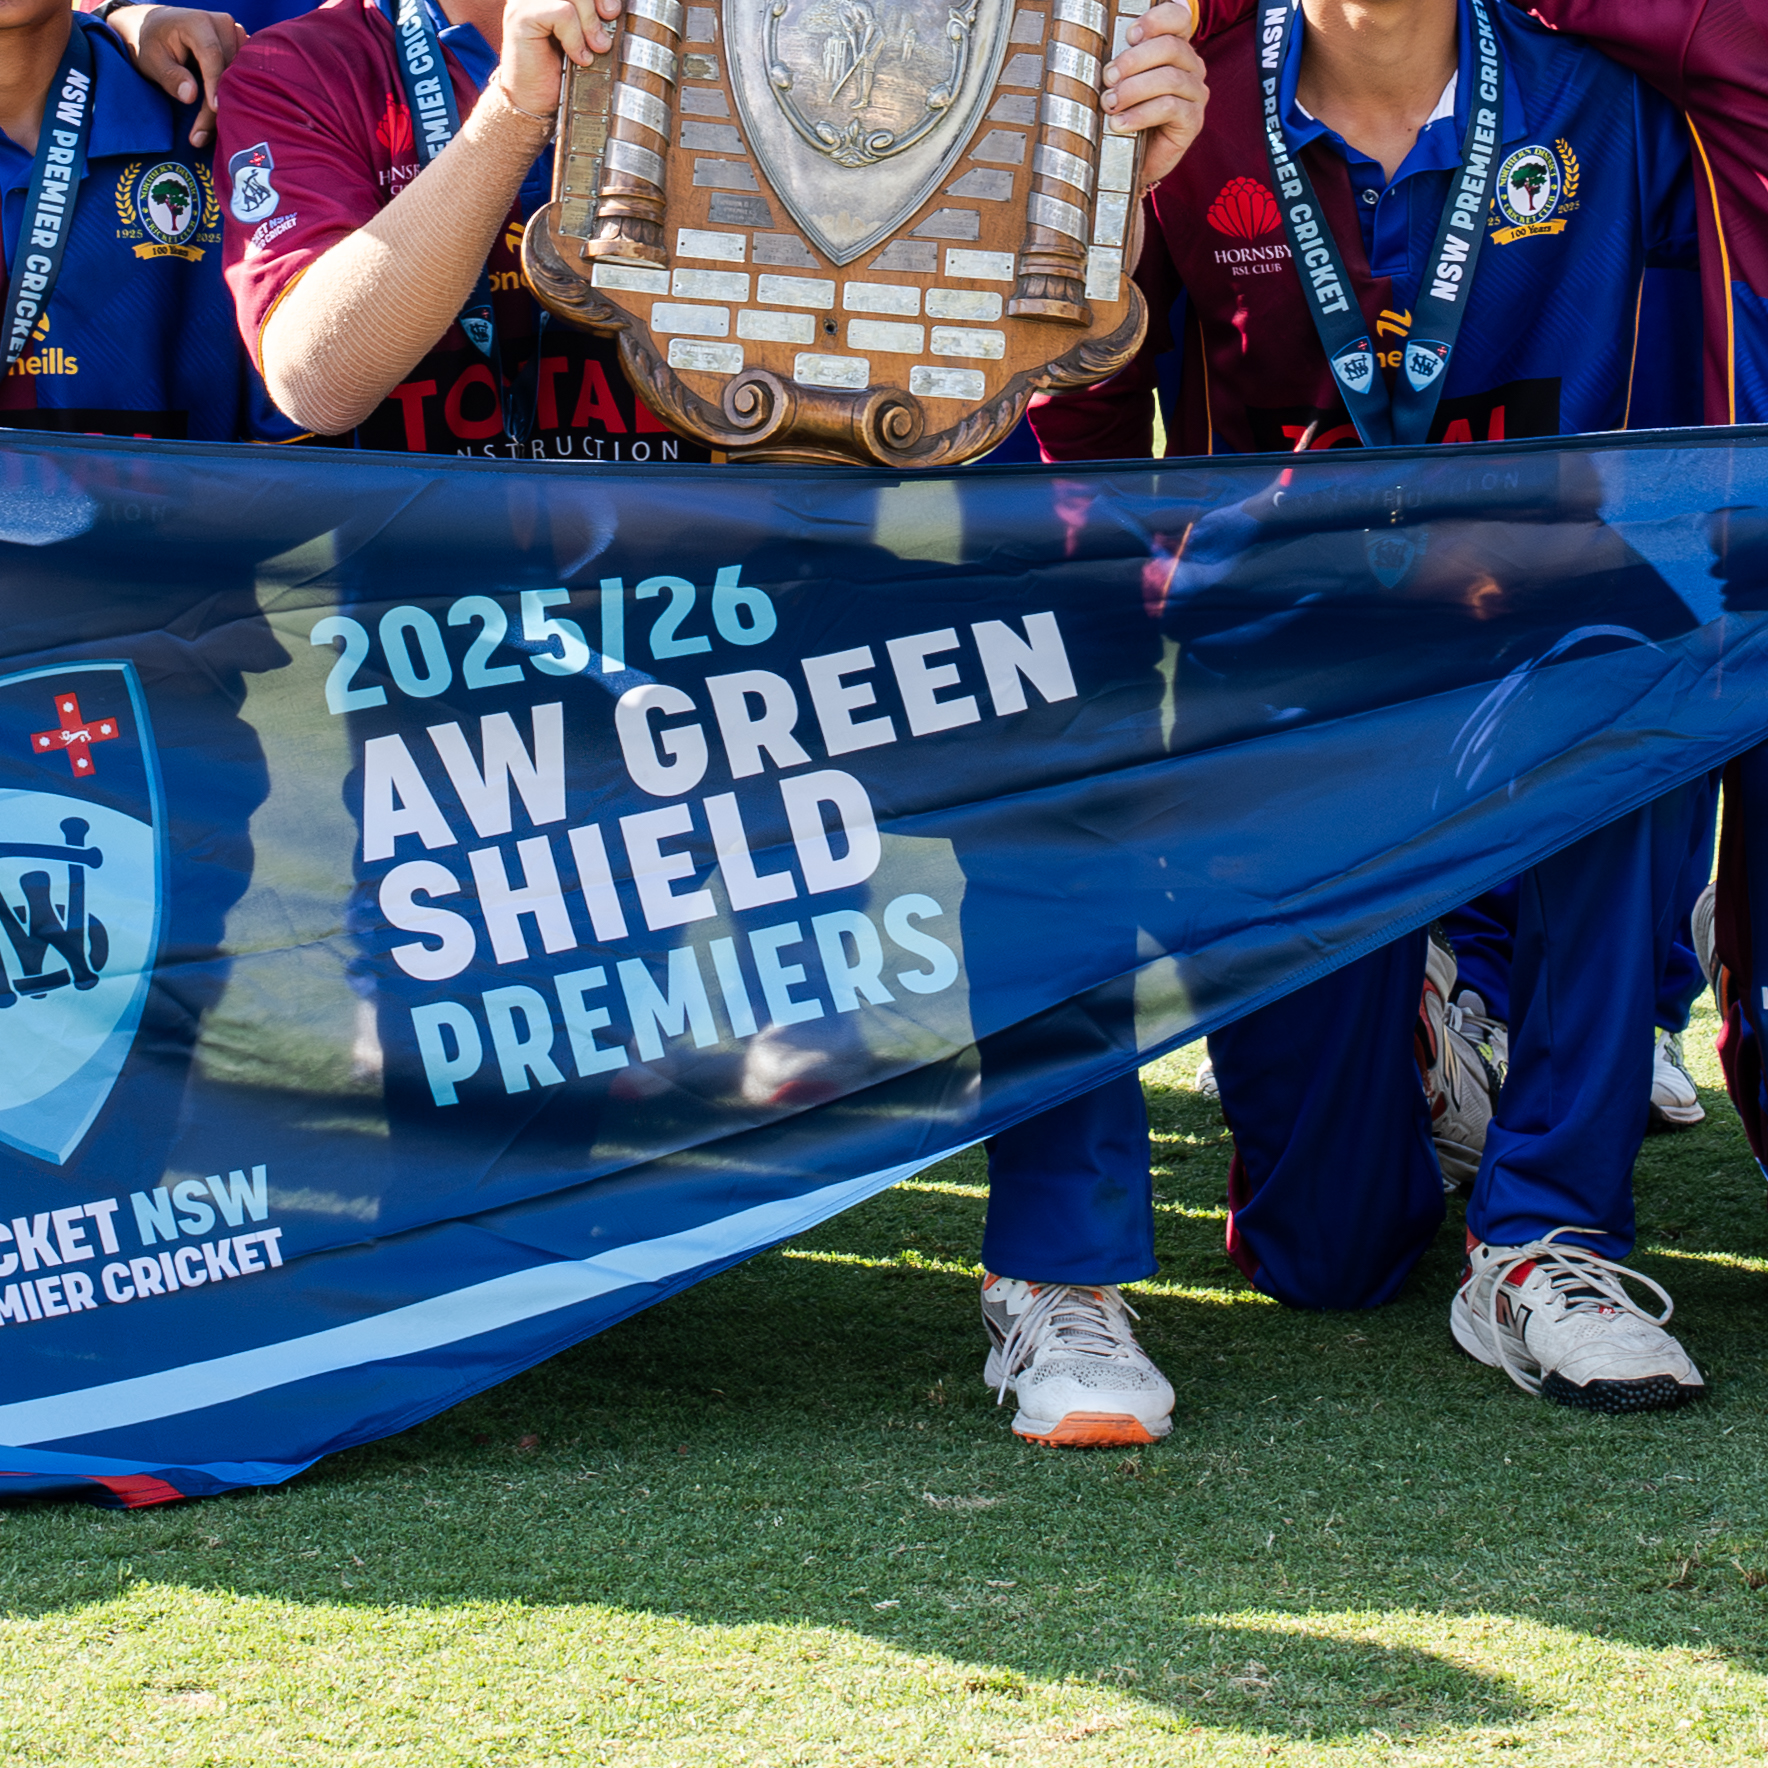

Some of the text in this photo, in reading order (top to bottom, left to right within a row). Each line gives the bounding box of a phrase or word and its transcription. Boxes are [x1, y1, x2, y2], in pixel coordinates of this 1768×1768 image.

[1261, 6, 1350, 315] NSW PREMIER CRICKET
[6, 68, 91, 364] NSW PREMIER CRICKET
[117, 228, 222, 244] 1925 2025
[265, 217, 297, 243] CRICKET
[1429, 234, 1473, 302] NSW
[1457, 108, 1498, 231] PREMIER
[1501, 202, 1537, 225] CRICKET
[1509, 223, 1553, 240] 100 Years
[1558, 201, 1580, 214] 2025
[152, 246, 168, 257] 100
[1214, 243, 1294, 264] HORNSBY
[1232, 262, 1283, 276] RSL CLUB
[310, 564, 777, 715] 2025/26
[363, 610, 1078, 863] AW GREEN
[378, 769, 882, 981] SHIELD
[410, 893, 960, 1107] PREMIERS
[129, 1163, 269, 1246] NSW
[100, 1227, 283, 1303] CRICKET
